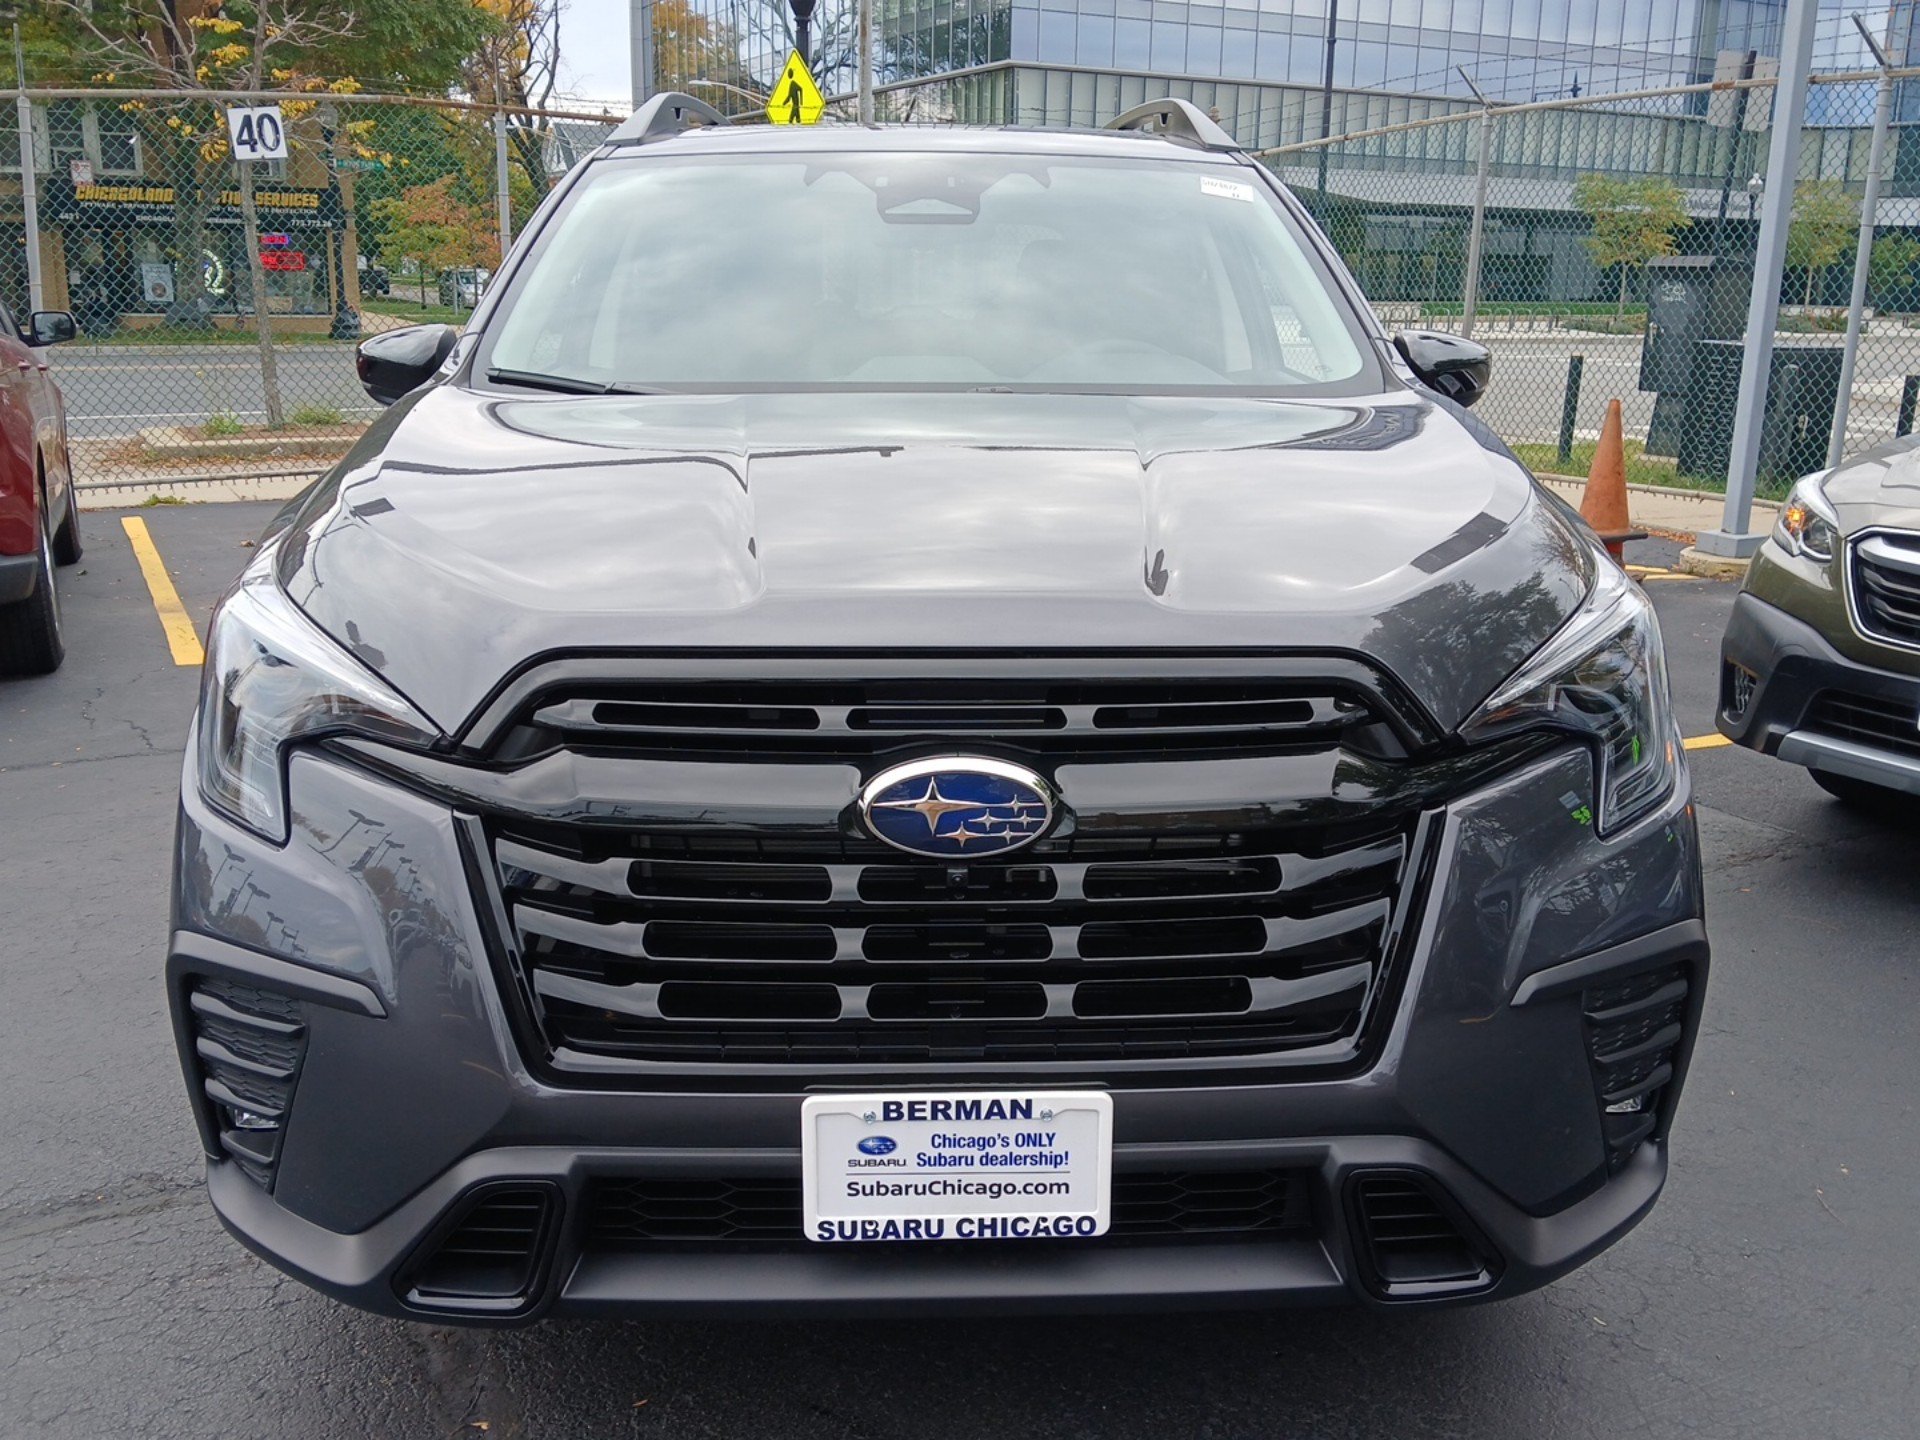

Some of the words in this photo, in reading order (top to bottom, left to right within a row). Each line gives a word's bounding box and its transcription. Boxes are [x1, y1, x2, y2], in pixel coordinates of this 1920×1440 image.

[236, 113, 281, 153] 40
[75, 186, 174, 203] CHICAGOLAND
[255, 191, 319, 208] SERVICES
[882, 1098, 1033, 1122] BERMAN
[931, 1133, 1010, 1150] Chicago's
[1014, 1132, 1057, 1148] ONLY
[847, 1158, 905, 1168] SUBARU
[916, 1152, 975, 1168] Subaru
[979, 1150, 1069, 1168] dealership!
[846, 1179, 1071, 1199] SubaruChicago.com
[816, 1218, 945, 1242] SUBARU
[955, 1215, 1098, 1238] CHICAGO
